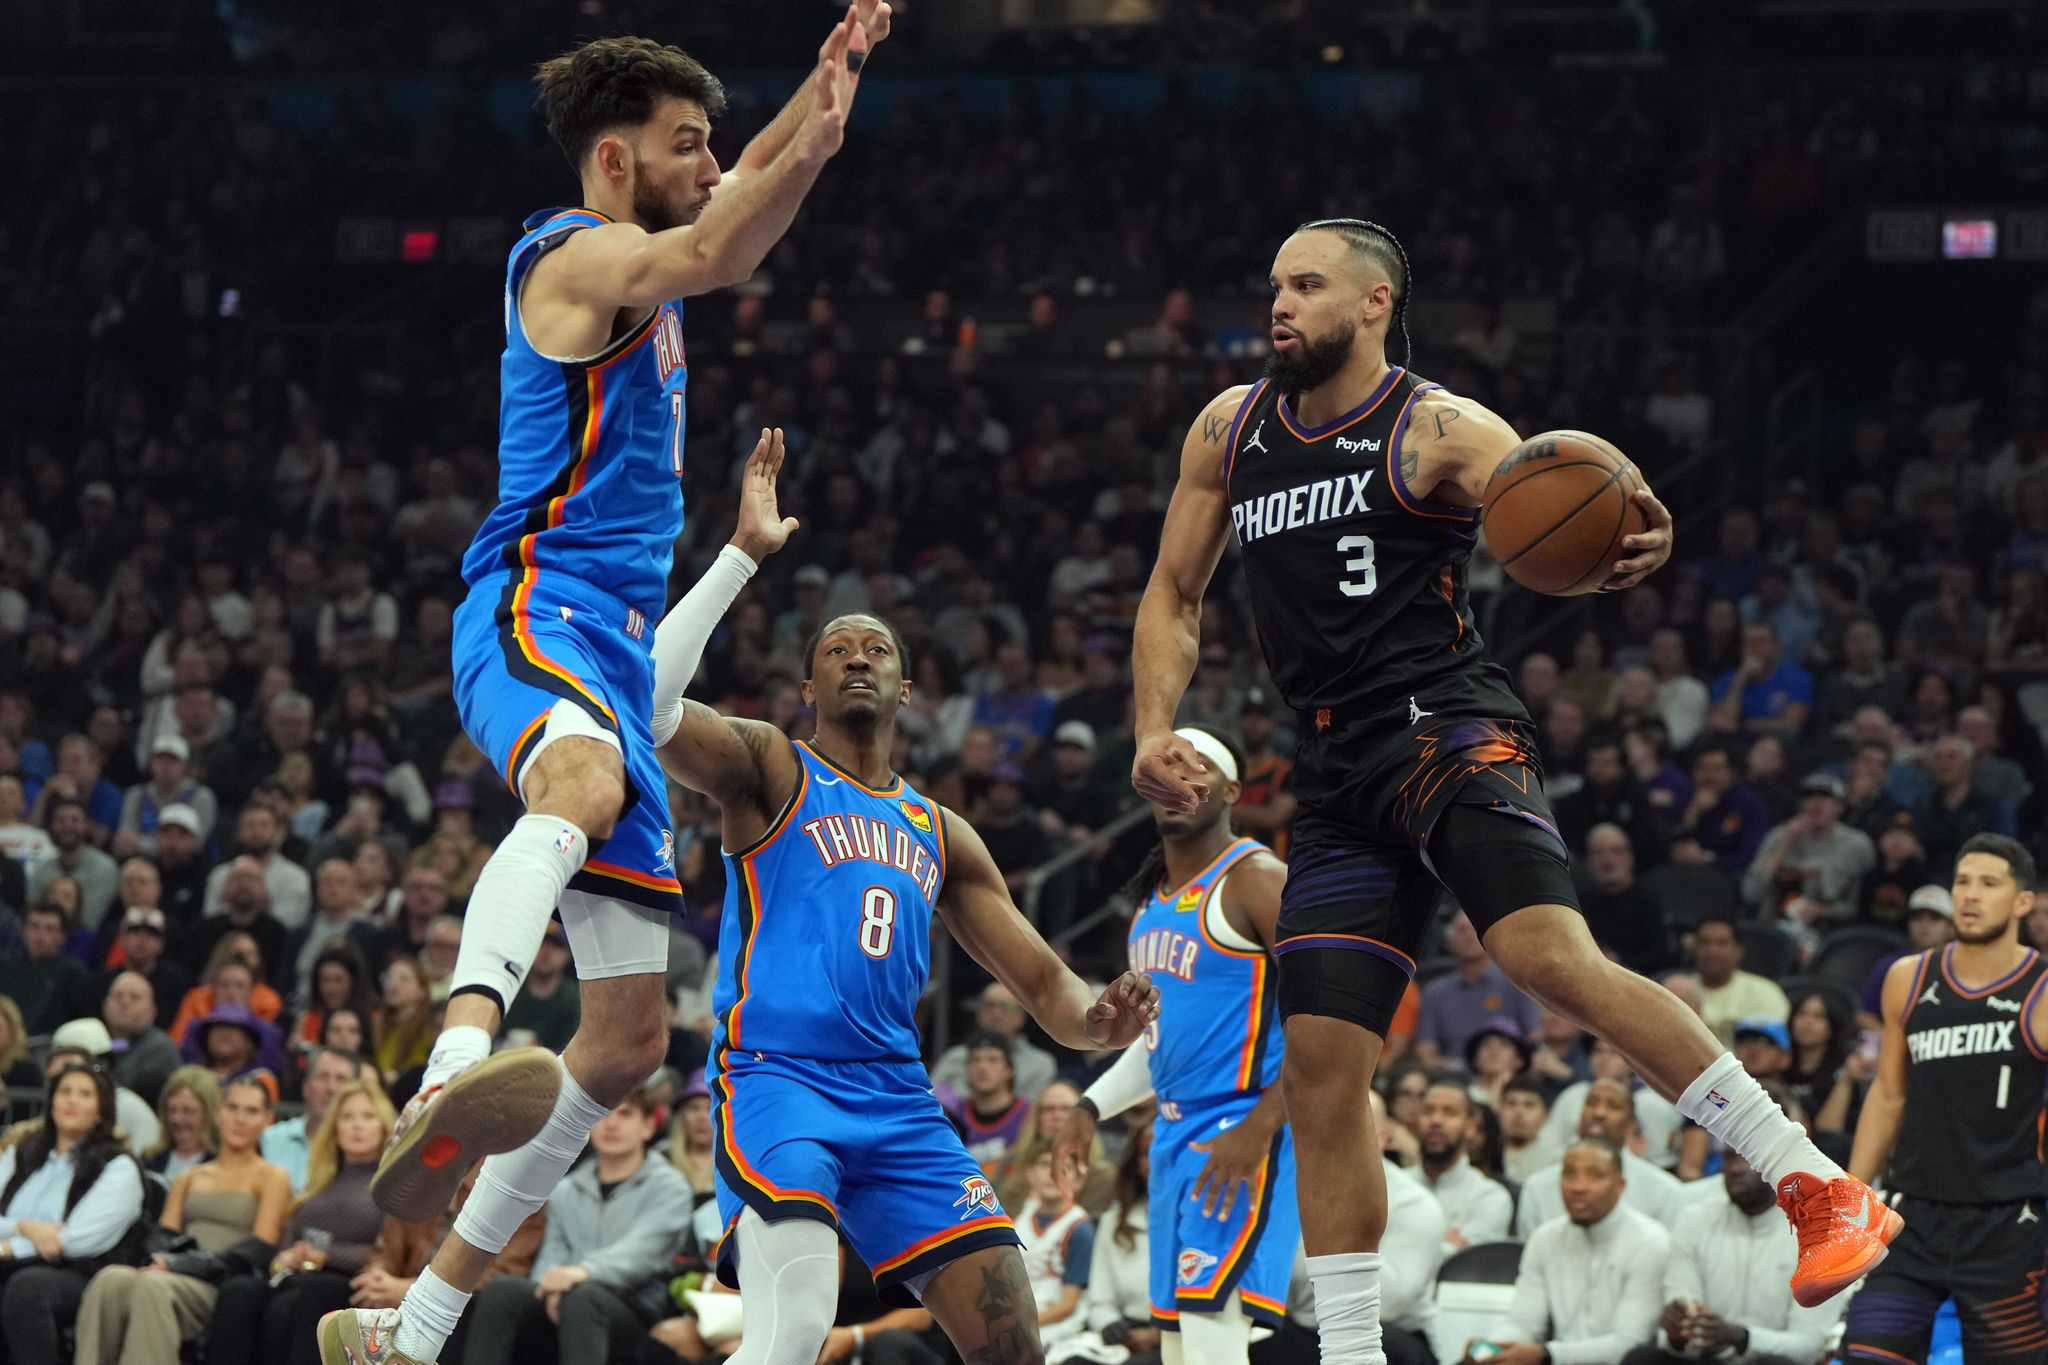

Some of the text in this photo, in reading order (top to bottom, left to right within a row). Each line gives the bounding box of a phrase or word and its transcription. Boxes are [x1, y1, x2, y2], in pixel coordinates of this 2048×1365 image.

[672, 390, 683, 475] 7
[1335, 437, 1381, 453] PayPal
[1231, 468, 1376, 547] PHOENIX
[1336, 535, 1377, 597] 3
[802, 814, 937, 906] THUNDER
[858, 885, 897, 960] 8
[1907, 1020, 2016, 1065] PHOENIX
[1996, 1064, 2012, 1109] 1
